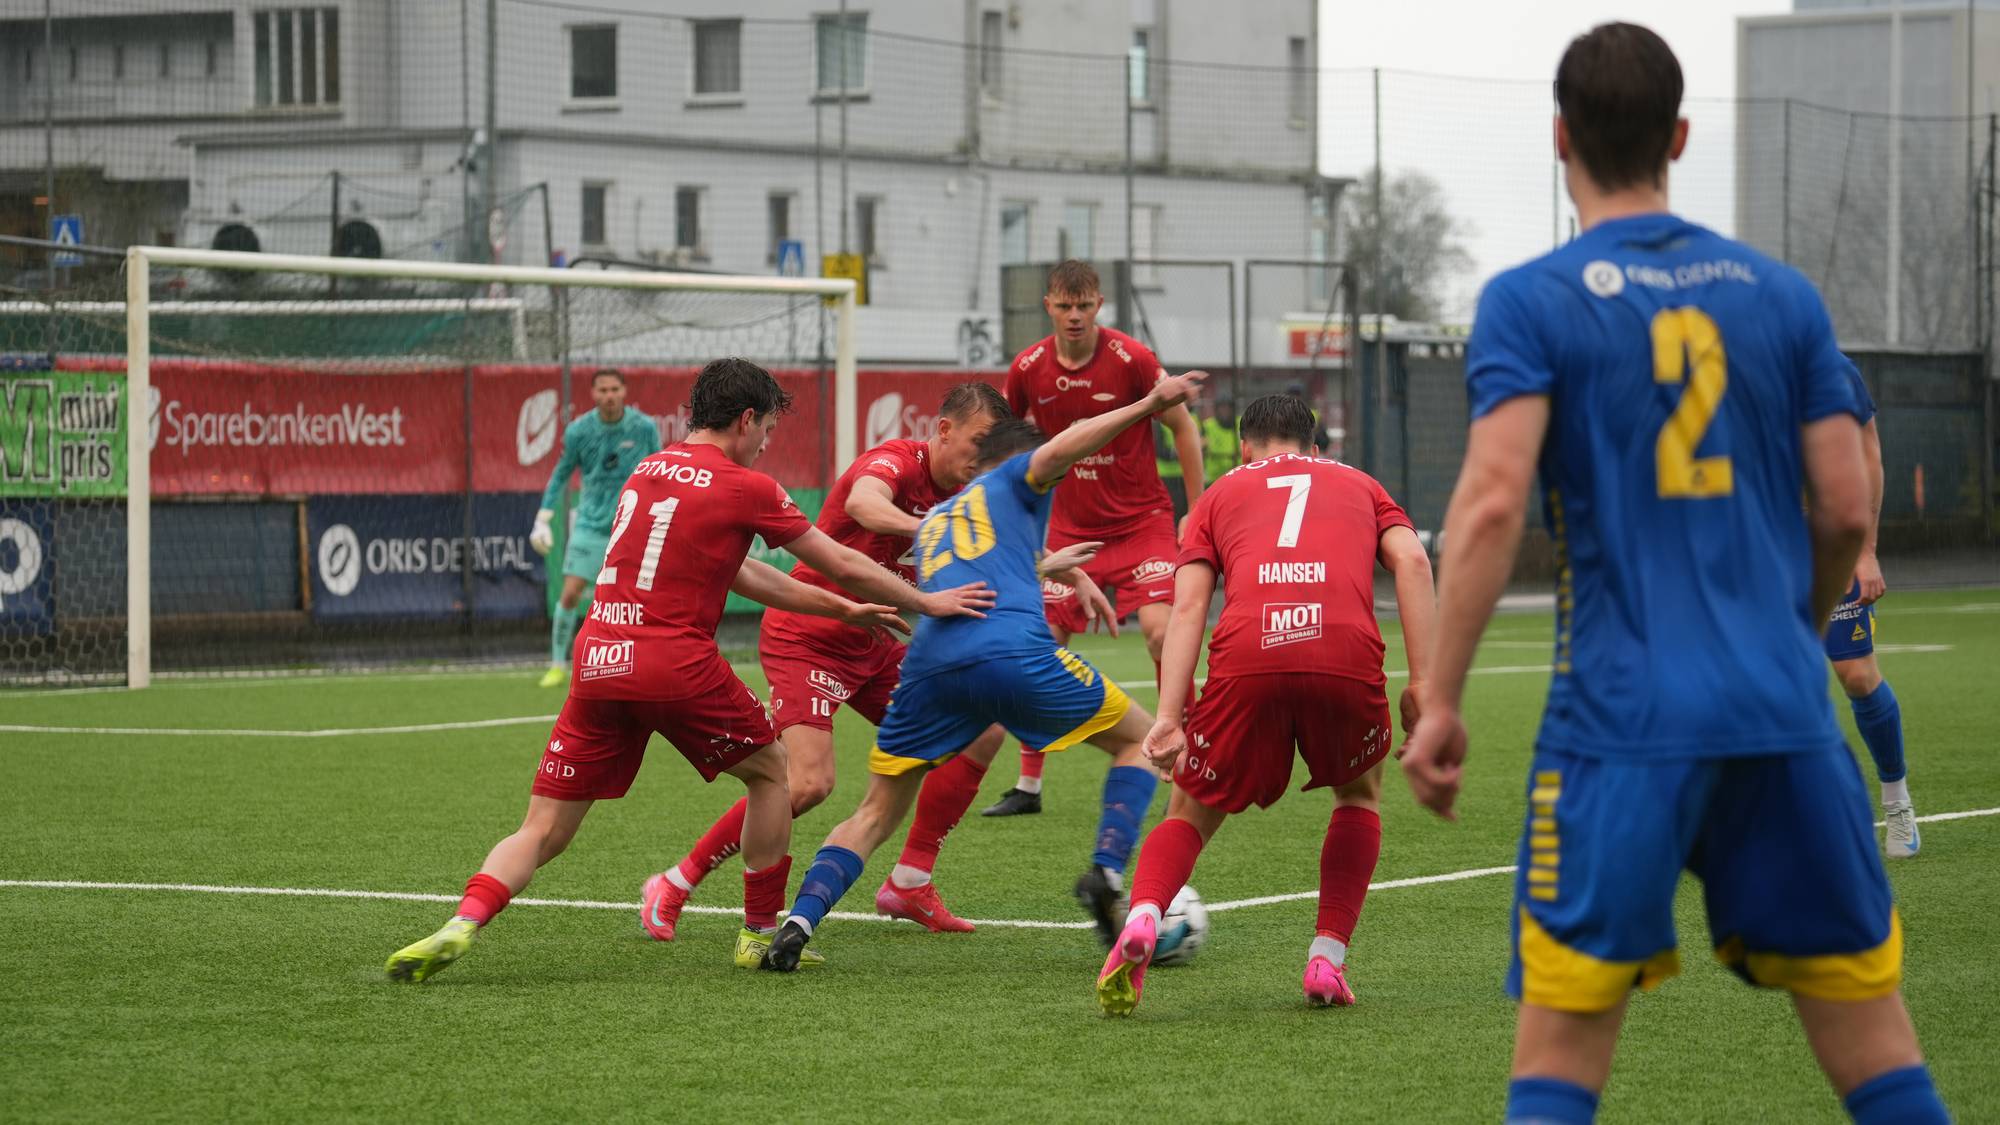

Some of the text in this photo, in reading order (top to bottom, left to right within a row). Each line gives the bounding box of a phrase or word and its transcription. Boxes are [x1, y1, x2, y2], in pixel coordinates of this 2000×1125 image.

[1650, 305, 1734, 499] 2
[60, 432, 112, 491] pris
[632, 459, 713, 488] OTMOB
[1266, 473, 1312, 548] 7
[596, 489, 679, 592] 21
[915, 484, 997, 583] 20
[366, 538, 427, 575] ORIS
[1258, 562, 1326, 584] HANSEN
[1042, 580, 1074, 597] RØY
[1270, 603, 1321, 632] MOT
[587, 641, 634, 667] MOT
[810, 697, 831, 717] 10
